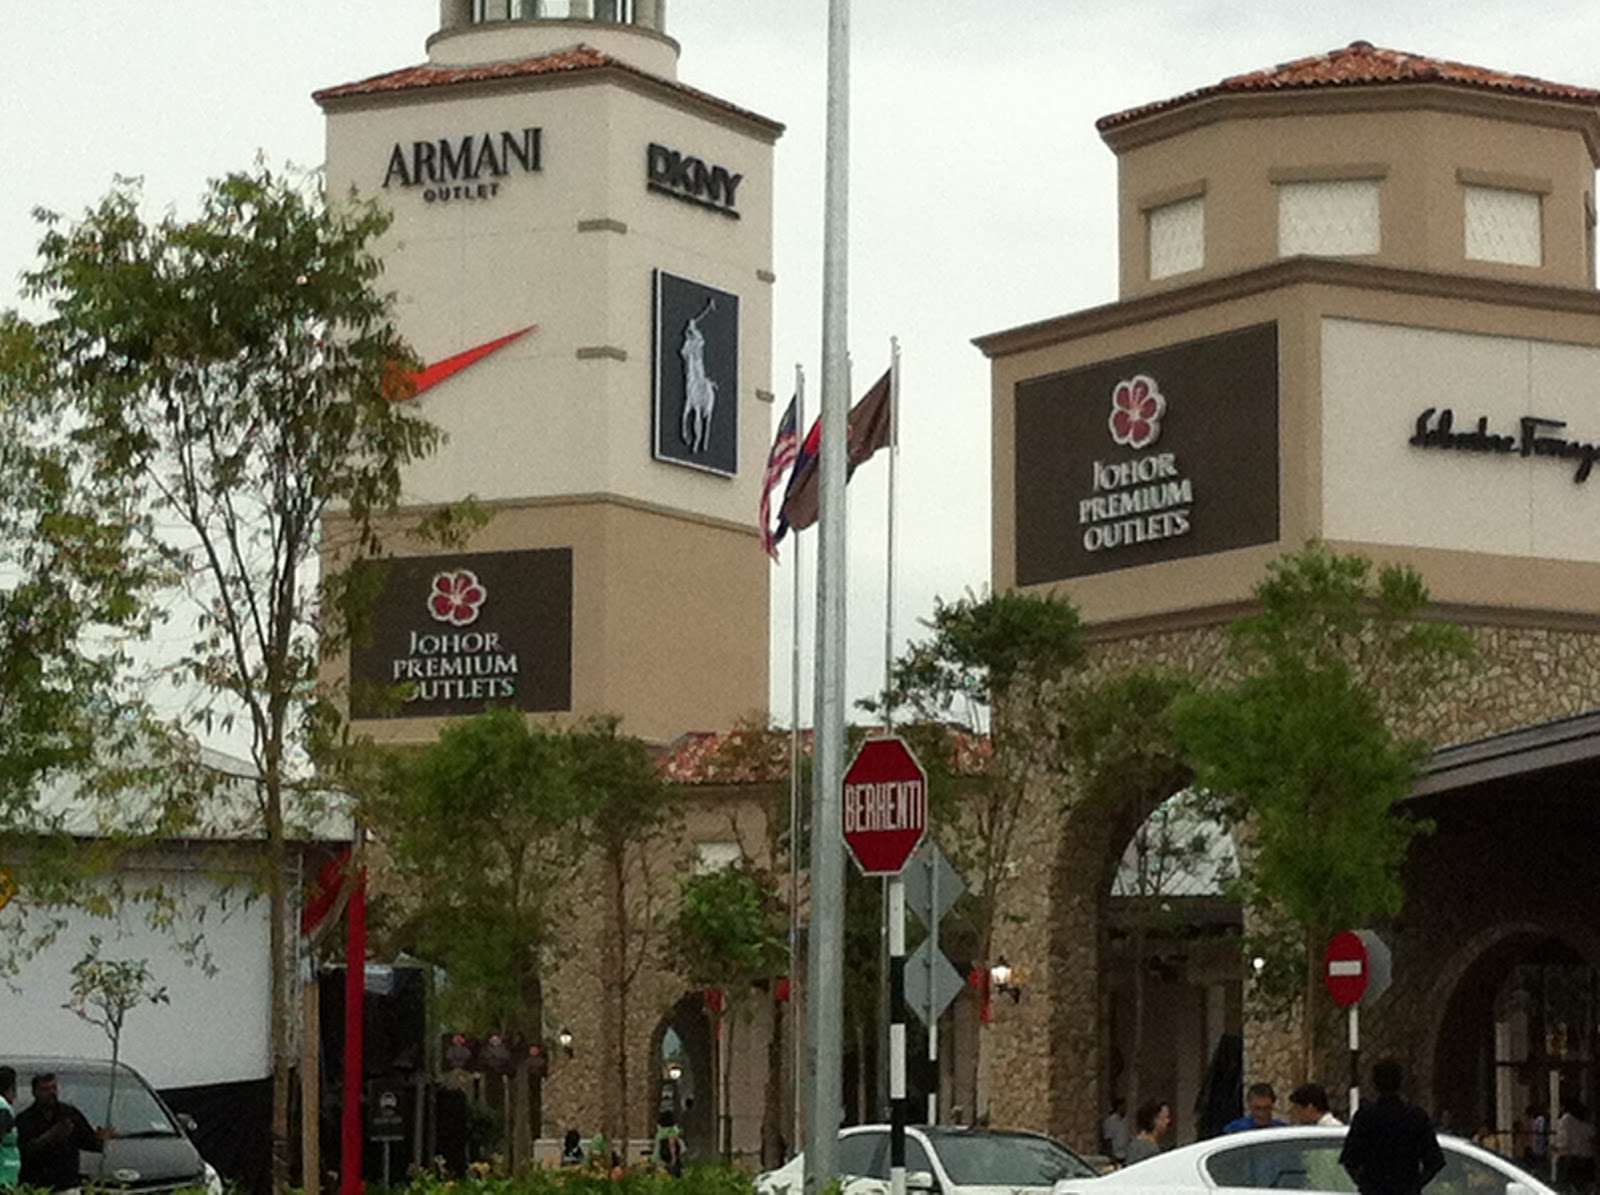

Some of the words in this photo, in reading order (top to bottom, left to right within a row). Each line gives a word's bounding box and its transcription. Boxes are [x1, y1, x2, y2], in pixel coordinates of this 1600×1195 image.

[383, 127, 542, 188] ARMANI
[646, 142, 743, 207] DKNY
[423, 183, 500, 203] OUTLET
[1093, 453, 1178, 491] JOHOR
[1079, 479, 1193, 524] PREMIUM
[1083, 510, 1191, 550] OUTLETS
[409, 631, 502, 655] JOHOR
[393, 654, 518, 679] PREMIUM
[845, 780, 921, 832] BERHENTI
